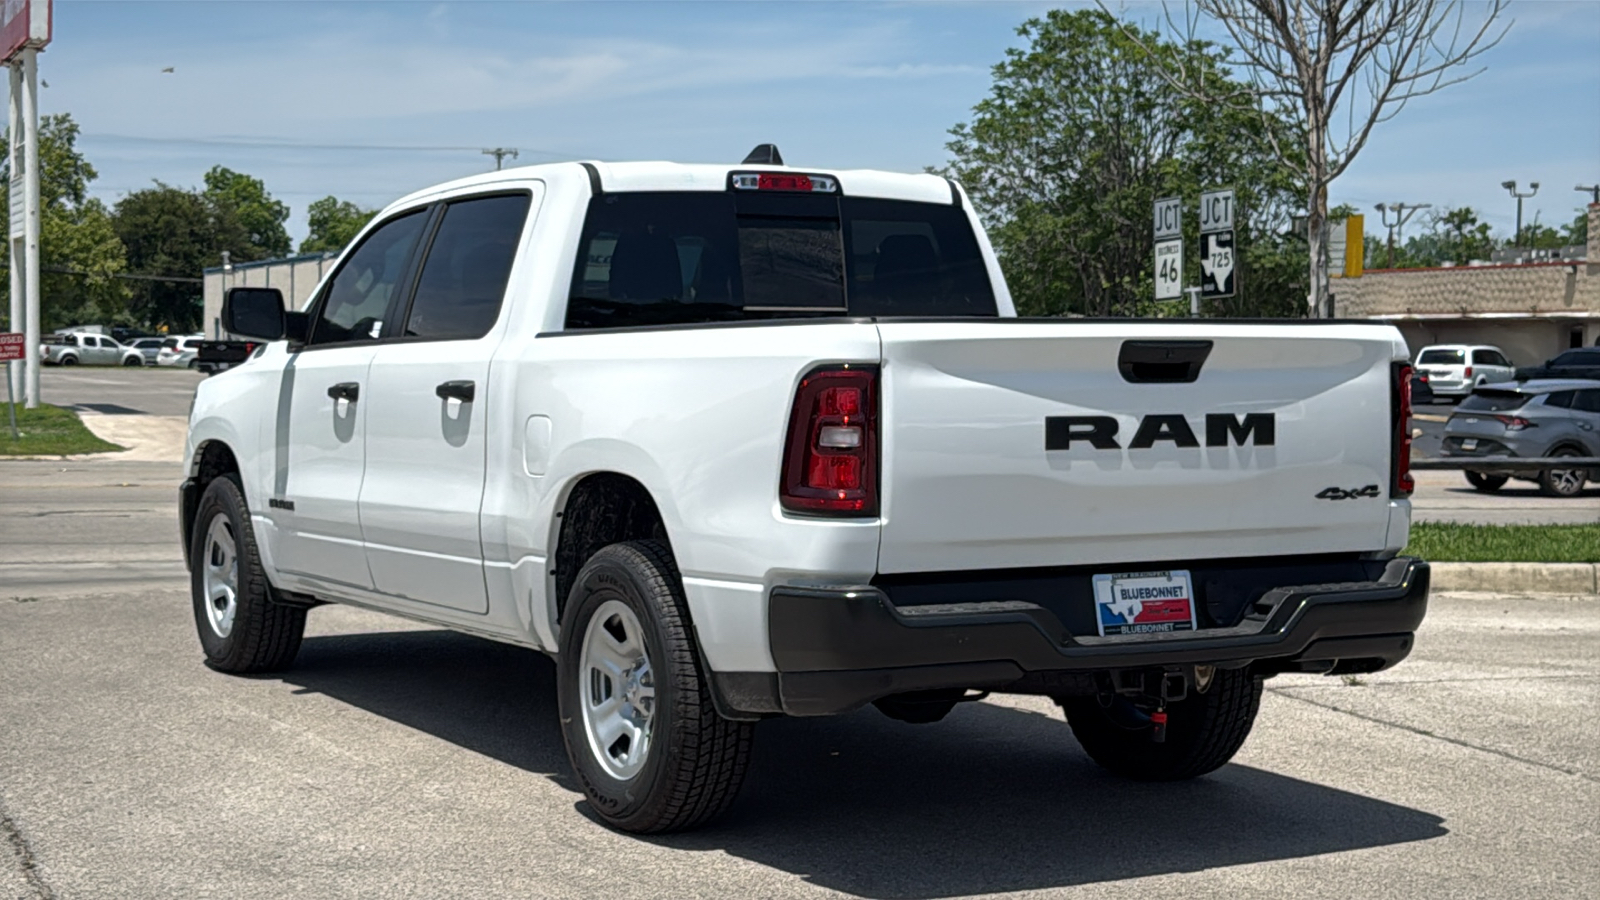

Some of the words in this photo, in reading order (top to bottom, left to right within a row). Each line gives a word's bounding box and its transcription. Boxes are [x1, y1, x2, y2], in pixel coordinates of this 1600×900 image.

[1156, 204, 1179, 232] JCT
[1202, 196, 1231, 225] JCT
[1211, 251, 1230, 268] 725
[1159, 258, 1178, 284] 46
[0, 335, 23, 345] OSED
[1045, 412, 1276, 451] RAM
[1120, 585, 1184, 600] BLUEBONNET
[1121, 623, 1174, 634] BLUEBONNET
